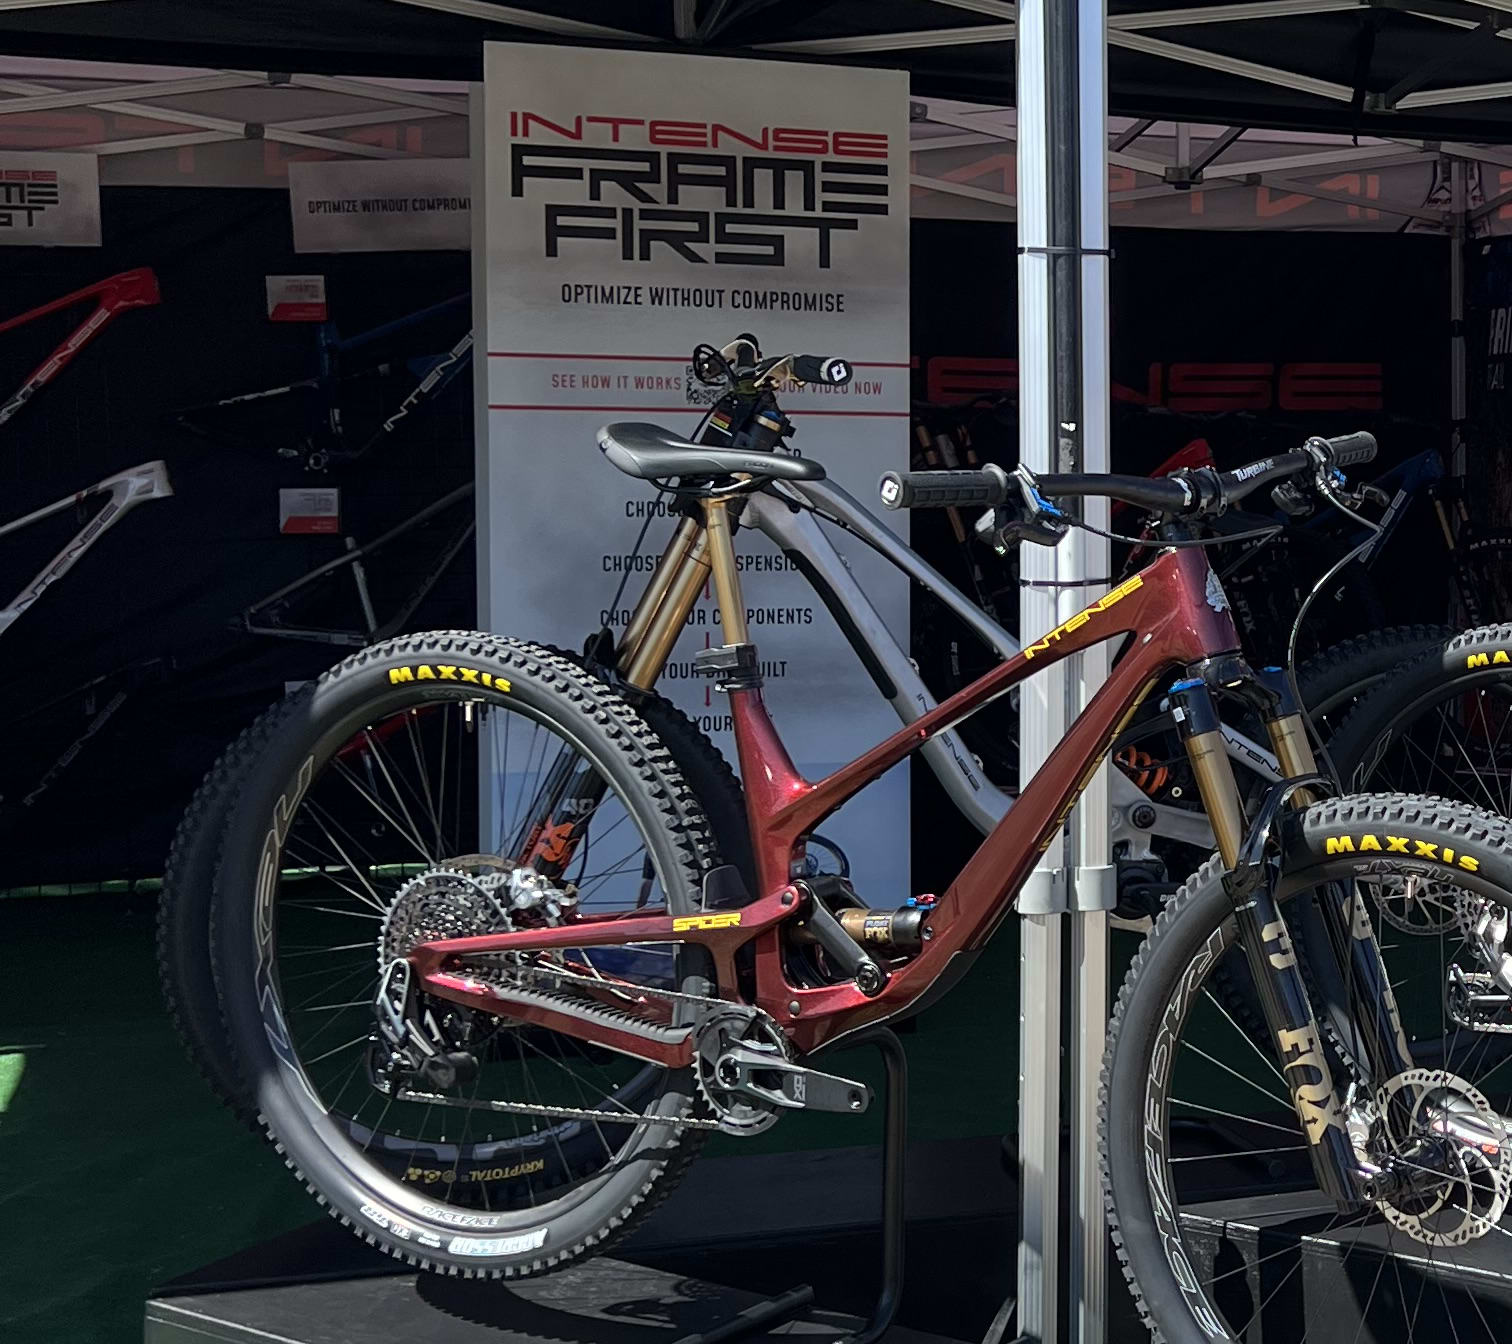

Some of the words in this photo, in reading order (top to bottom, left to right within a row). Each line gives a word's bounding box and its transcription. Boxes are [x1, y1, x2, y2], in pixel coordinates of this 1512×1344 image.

[509, 111, 889, 159] INTENSE
[510, 143, 889, 216] FRAME
[308, 200, 359, 214] OPTIMIZE
[362, 199, 408, 213] WITHOUT
[545, 203, 859, 269] FIRST
[561, 283, 644, 306] OPTIMIZE
[649, 286, 726, 309] WITHOUT
[731, 289, 845, 313] COMPROMISE
[551, 373, 577, 388] SEE
[581, 374, 610, 389] HOW
[617, 376, 630, 389] IT
[634, 376, 682, 391] WORKS
[854, 381, 883, 396] NOW
[1230, 457, 1275, 484] TURBINE
[625, 501, 684, 517] CHOOS
[713, 607, 813, 625] CPONENTS
[1023, 574, 1145, 660] INTENSE
[389, 664, 512, 694] MAXXIS
[1325, 833, 1481, 874] MAXXIS
[672, 912, 742, 933] SPIDER
[1278, 1020, 1348, 1146] FOX
[469, 1158, 545, 1183] KRYPTOTAL
